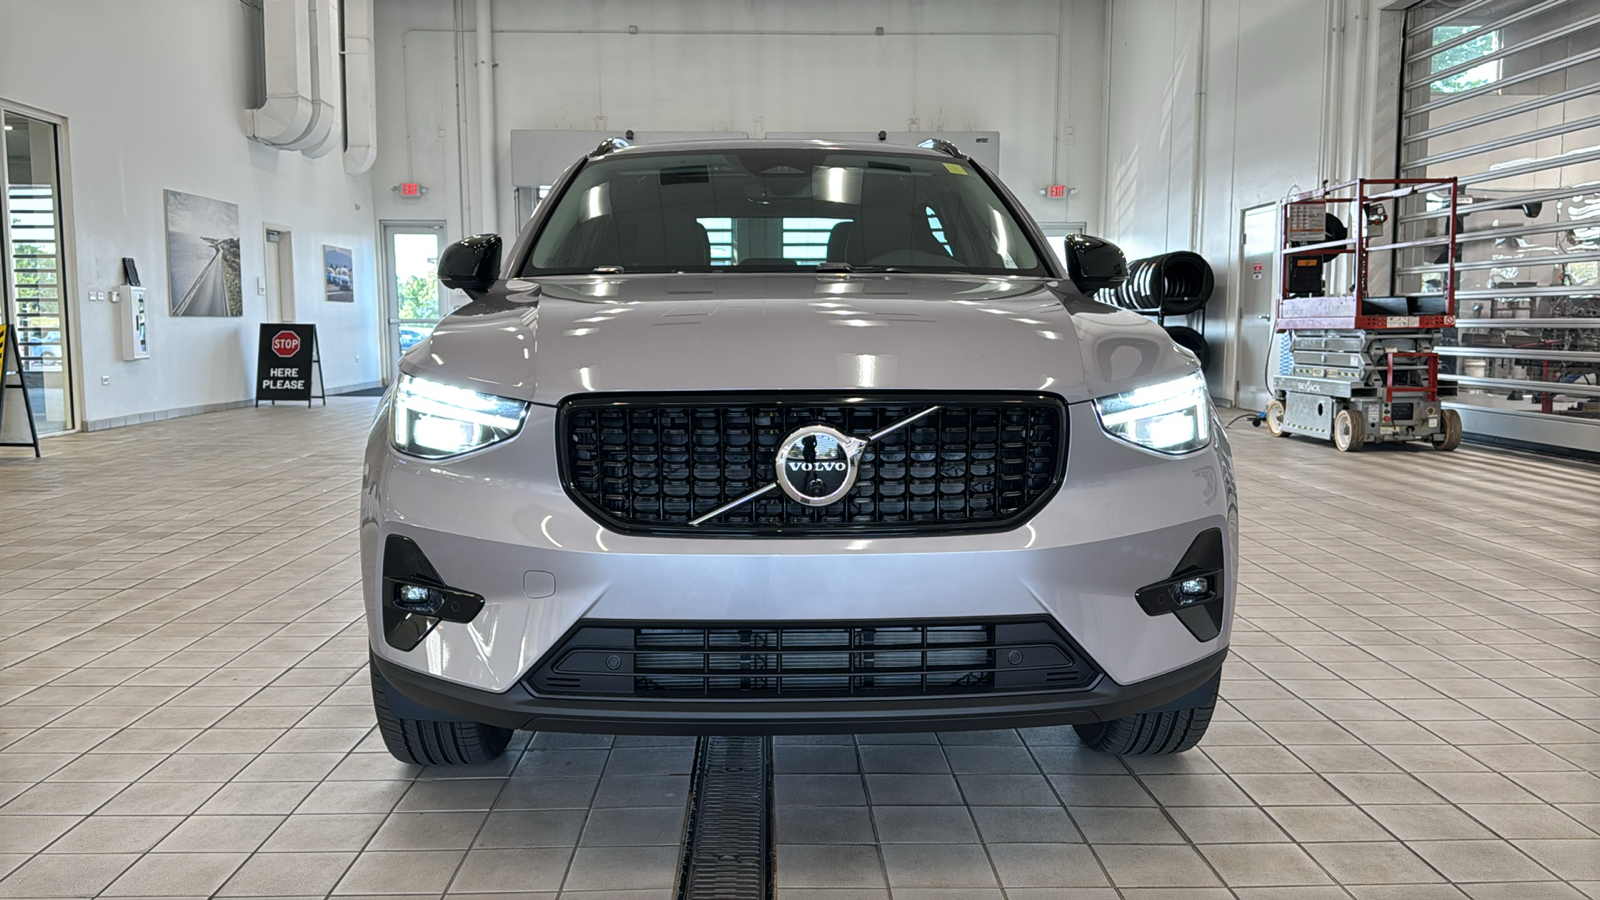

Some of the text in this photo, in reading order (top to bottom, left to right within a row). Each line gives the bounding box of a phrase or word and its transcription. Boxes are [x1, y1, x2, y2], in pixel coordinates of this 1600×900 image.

[403, 183, 418, 195] EXIT
[1050, 186, 1065, 197] EXIT
[274, 339, 298, 349] STOP
[270, 368, 299, 377] HERE
[262, 380, 305, 389] PLEASE
[788, 462, 846, 471] VOLVO
